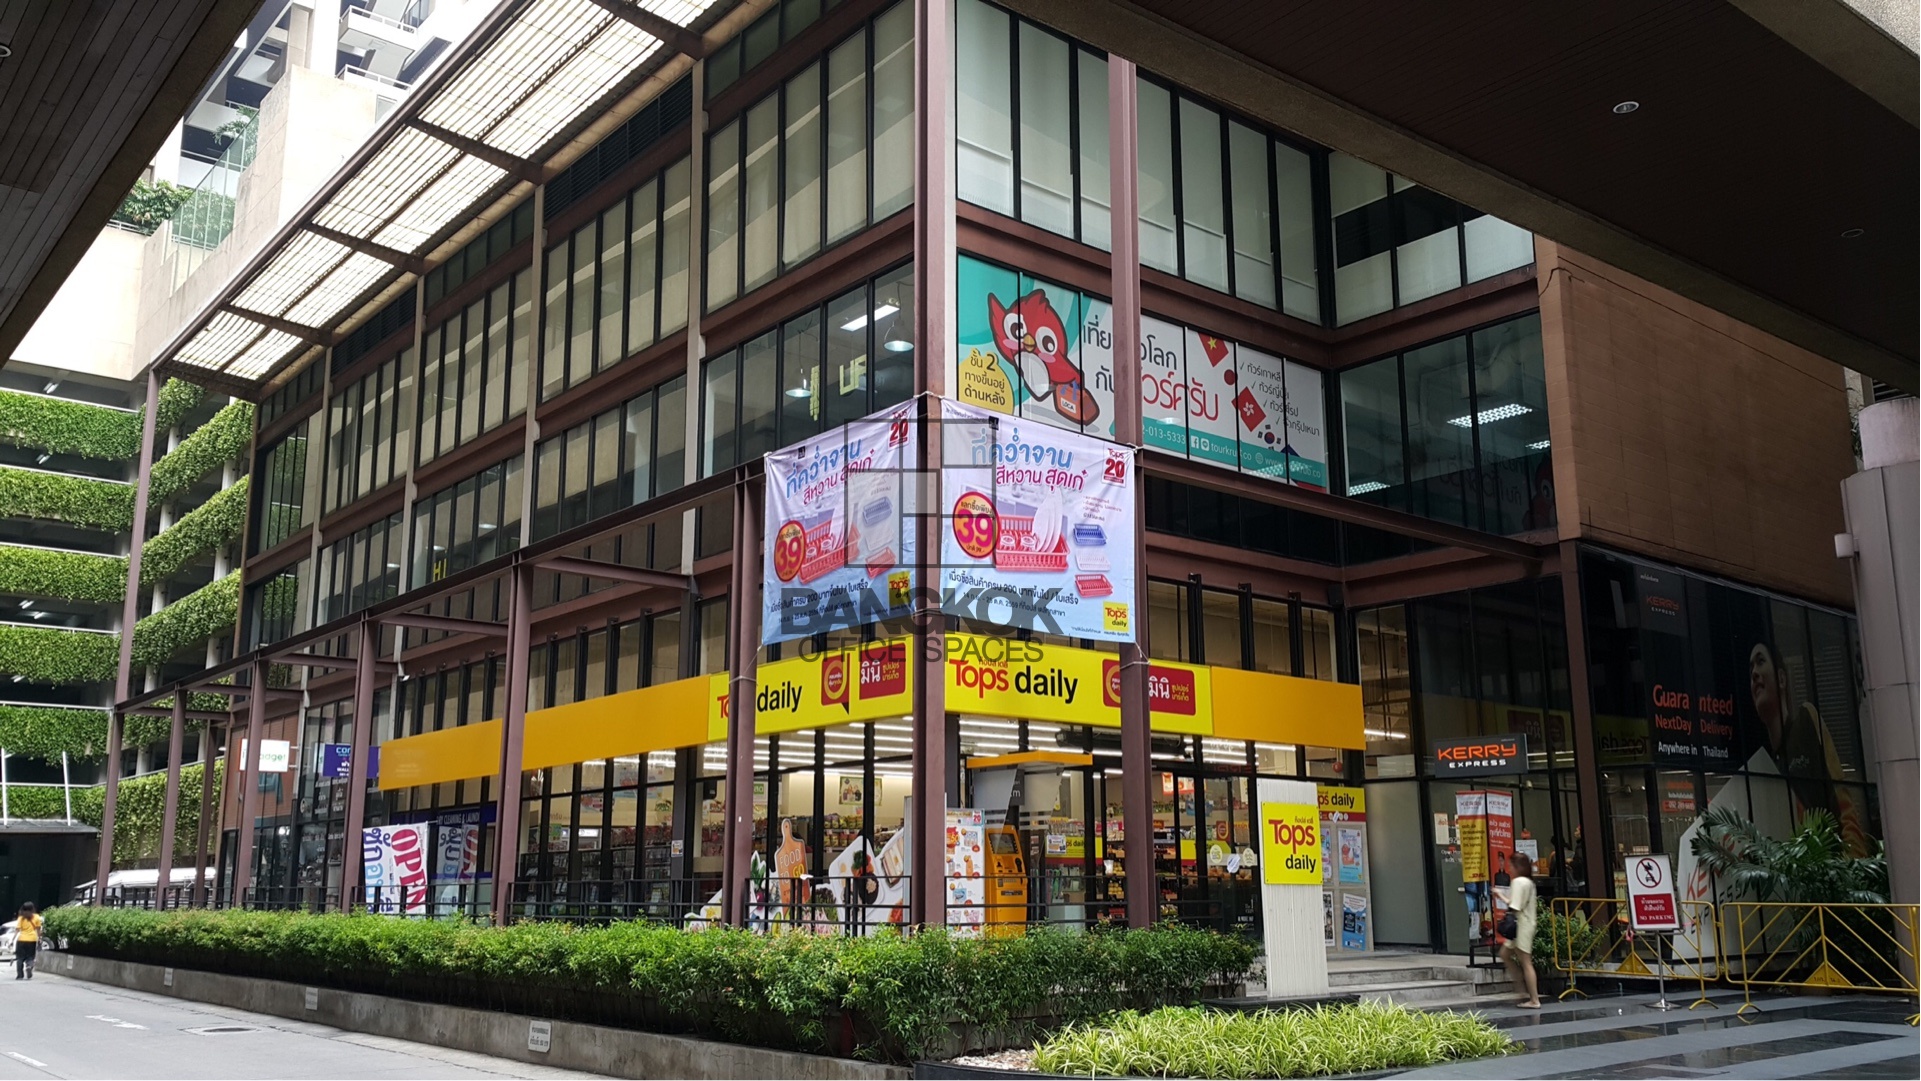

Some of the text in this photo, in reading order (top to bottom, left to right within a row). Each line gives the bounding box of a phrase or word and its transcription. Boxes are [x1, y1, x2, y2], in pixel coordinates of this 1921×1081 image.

[970, 350, 996, 372] ชั้น 2
[964, 370, 1005, 394] ทางขึ้นอยู่
[964, 386, 1006, 406] ด้านหลัง
[889, 419, 909, 442] 20
[1142, 426, 1186, 445] 2-013-5333
[972, 427, 1073, 469] ที่คว่ำจาน
[1107, 447, 1125, 460] Tops
[786, 438, 862, 499] ที่คว่ำจาน
[996, 467, 1042, 485] สีหวาน
[1104, 458, 1126, 478] 20
[803, 473, 838, 506] สีหวาน
[957, 509, 993, 547] 39
[776, 537, 802, 572] 39
[1004, 585, 1017, 595] 200
[1105, 607, 1127, 621] Tops
[1112, 620, 1127, 628] daily
[861, 659, 881, 685] มินิ
[949, 658, 1079, 705] Tops daily
[717, 681, 803, 719] To daily
[1655, 713, 1733, 741] NextDay Delivery
[1438, 743, 1518, 761] KERRY
[1658, 741, 1729, 758] Anywhere in Thailand
[1449, 759, 1507, 769] EXPRESS
[1331, 793, 1355, 809] daily
[1268, 819, 1316, 855] Tops
[780, 848, 801, 869] FOOD
[1285, 854, 1317, 873] daily
[390, 829, 428, 911] OPEN
[793, 863, 805, 878] GO
